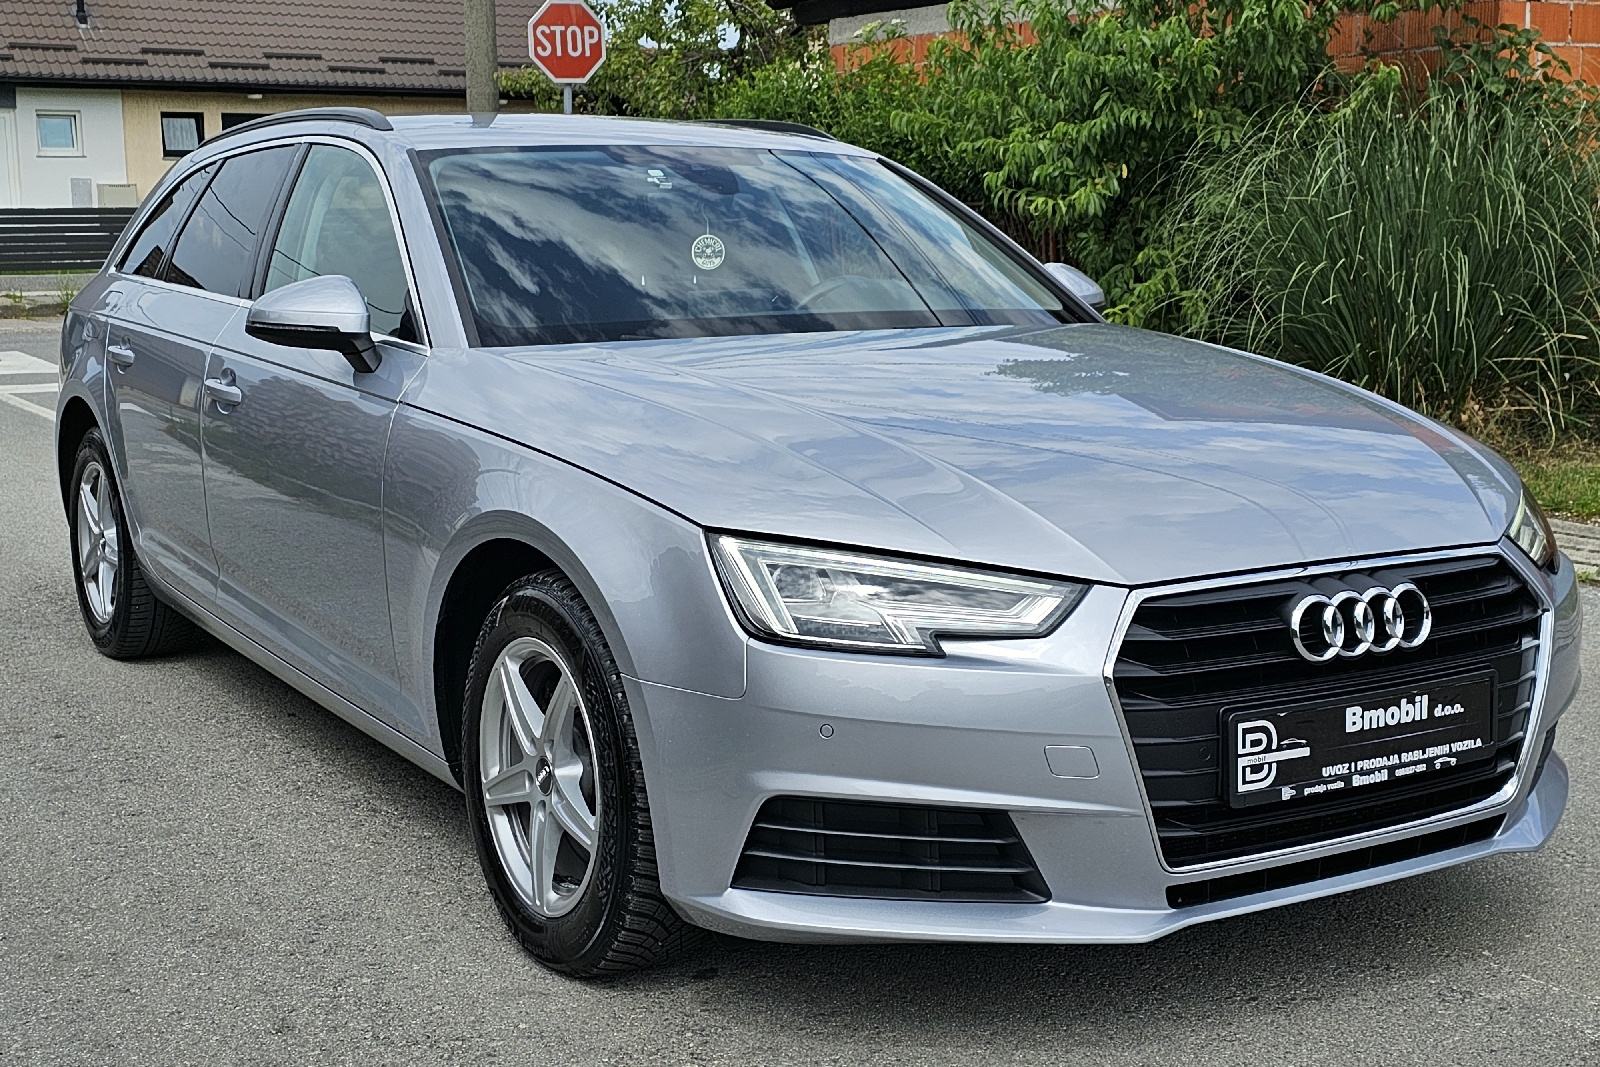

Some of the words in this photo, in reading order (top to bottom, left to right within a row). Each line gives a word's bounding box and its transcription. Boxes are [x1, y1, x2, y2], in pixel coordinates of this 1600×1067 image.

[535, 25, 599, 57] STOP
[1345, 694, 1429, 733] Bmobil
[1434, 703, 1465, 717] d.o.o.
[1322, 762, 1350, 777] UVOZ
[1350, 761, 1355, 773] I
[1357, 754, 1399, 771] PRODAJA
[1401, 744, 1450, 764] RABLJENIH
[1451, 738, 1482, 753] VOZILA
[1352, 769, 1389, 787] Bmobil
